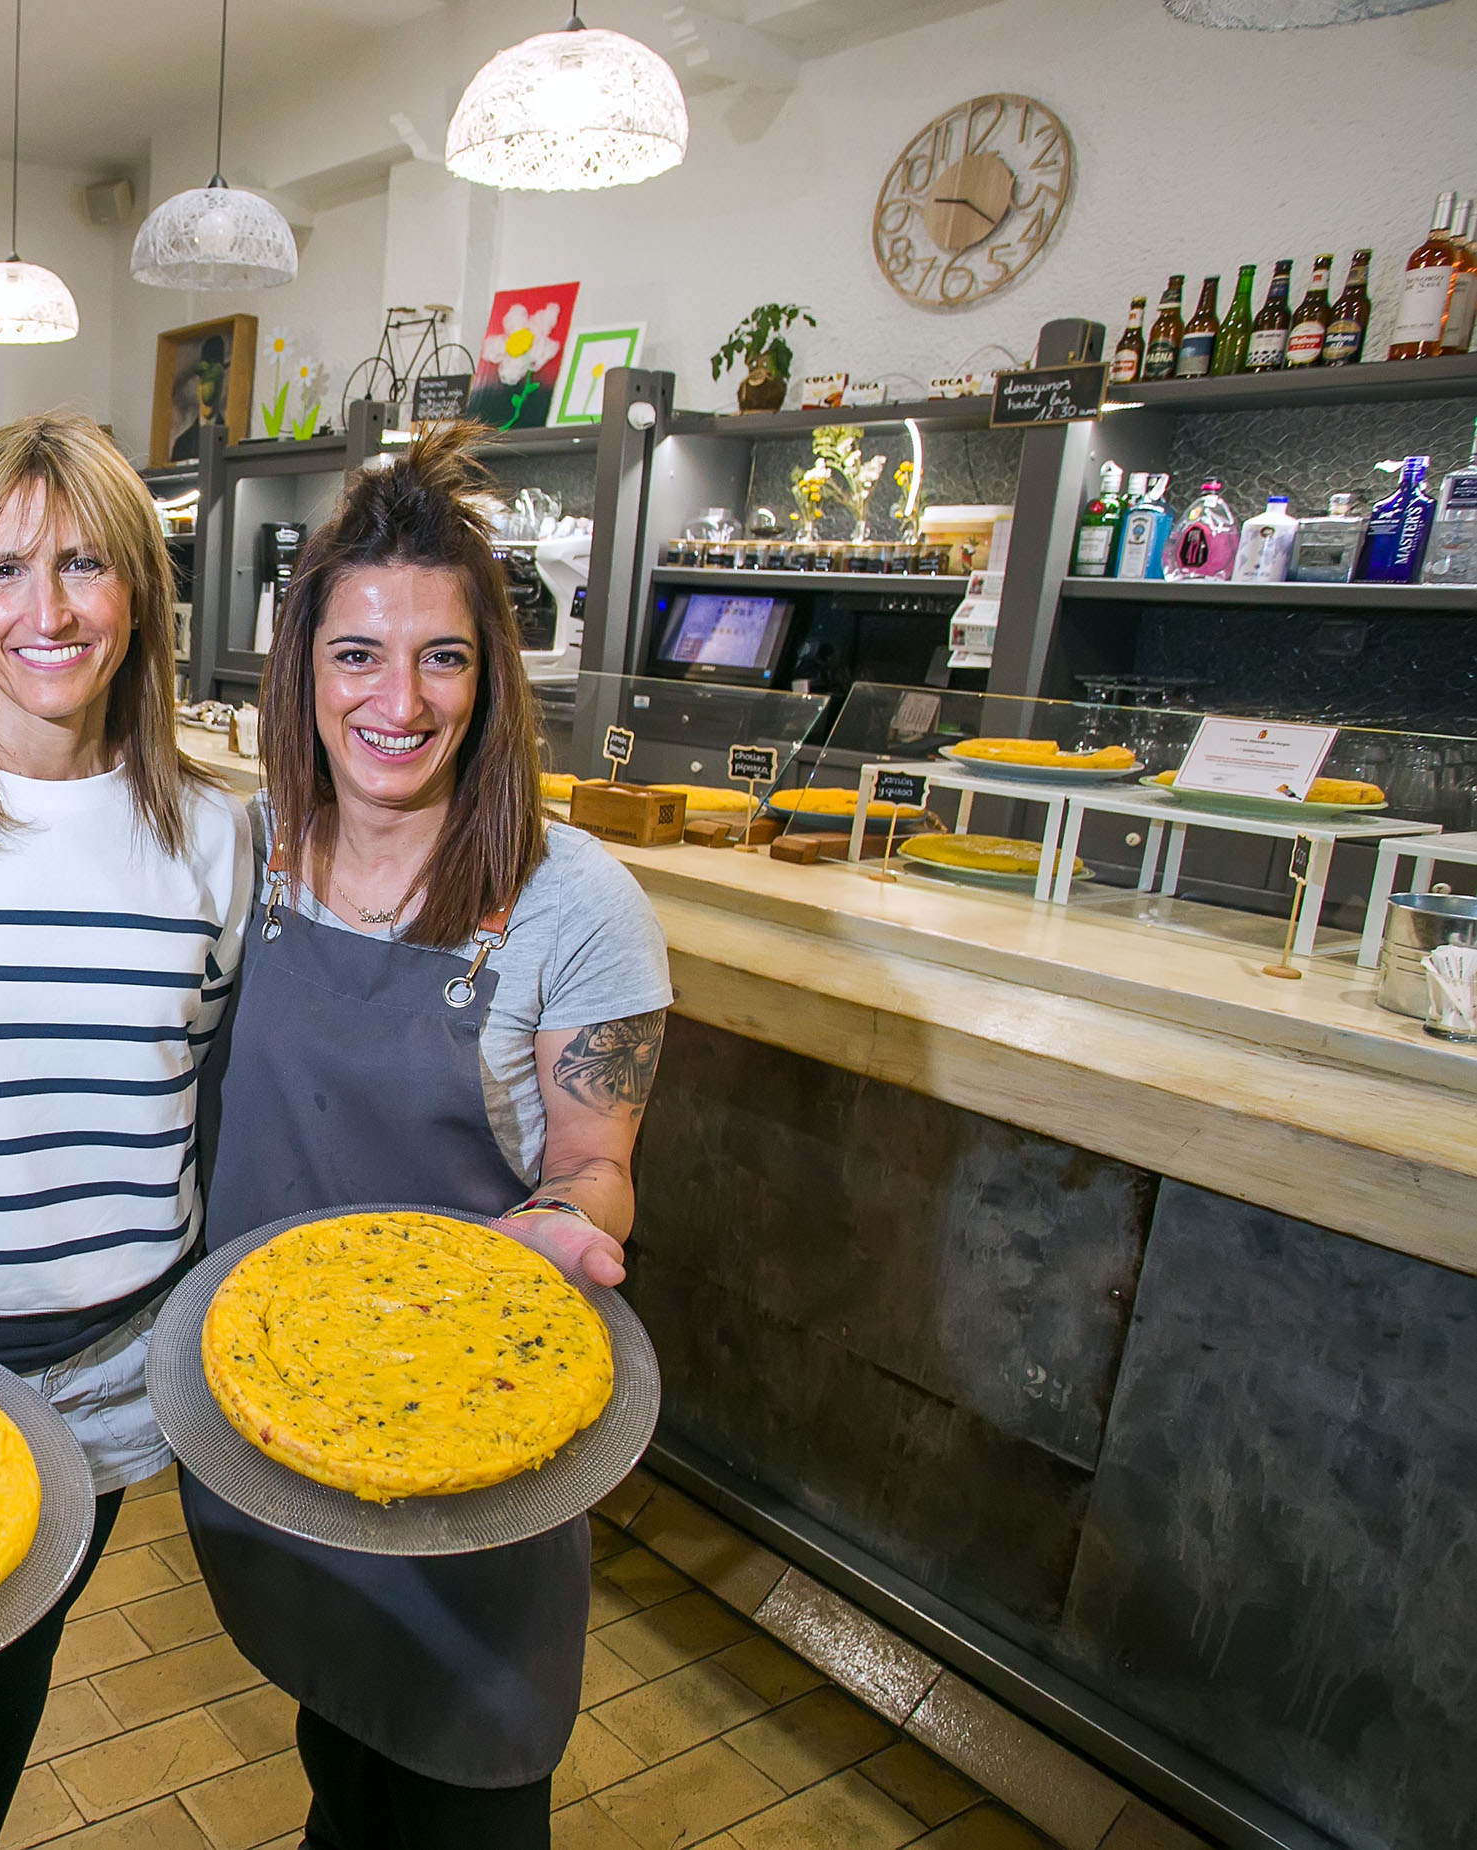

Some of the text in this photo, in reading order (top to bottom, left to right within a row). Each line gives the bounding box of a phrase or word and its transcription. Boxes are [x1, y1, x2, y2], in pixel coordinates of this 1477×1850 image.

[805, 375, 835, 385] CUCA
[931, 377, 964, 387] CUCA
[850, 382, 880, 392] CUCA
[1004, 378, 1072, 401] desayunos
[1048, 391, 1071, 406] las
